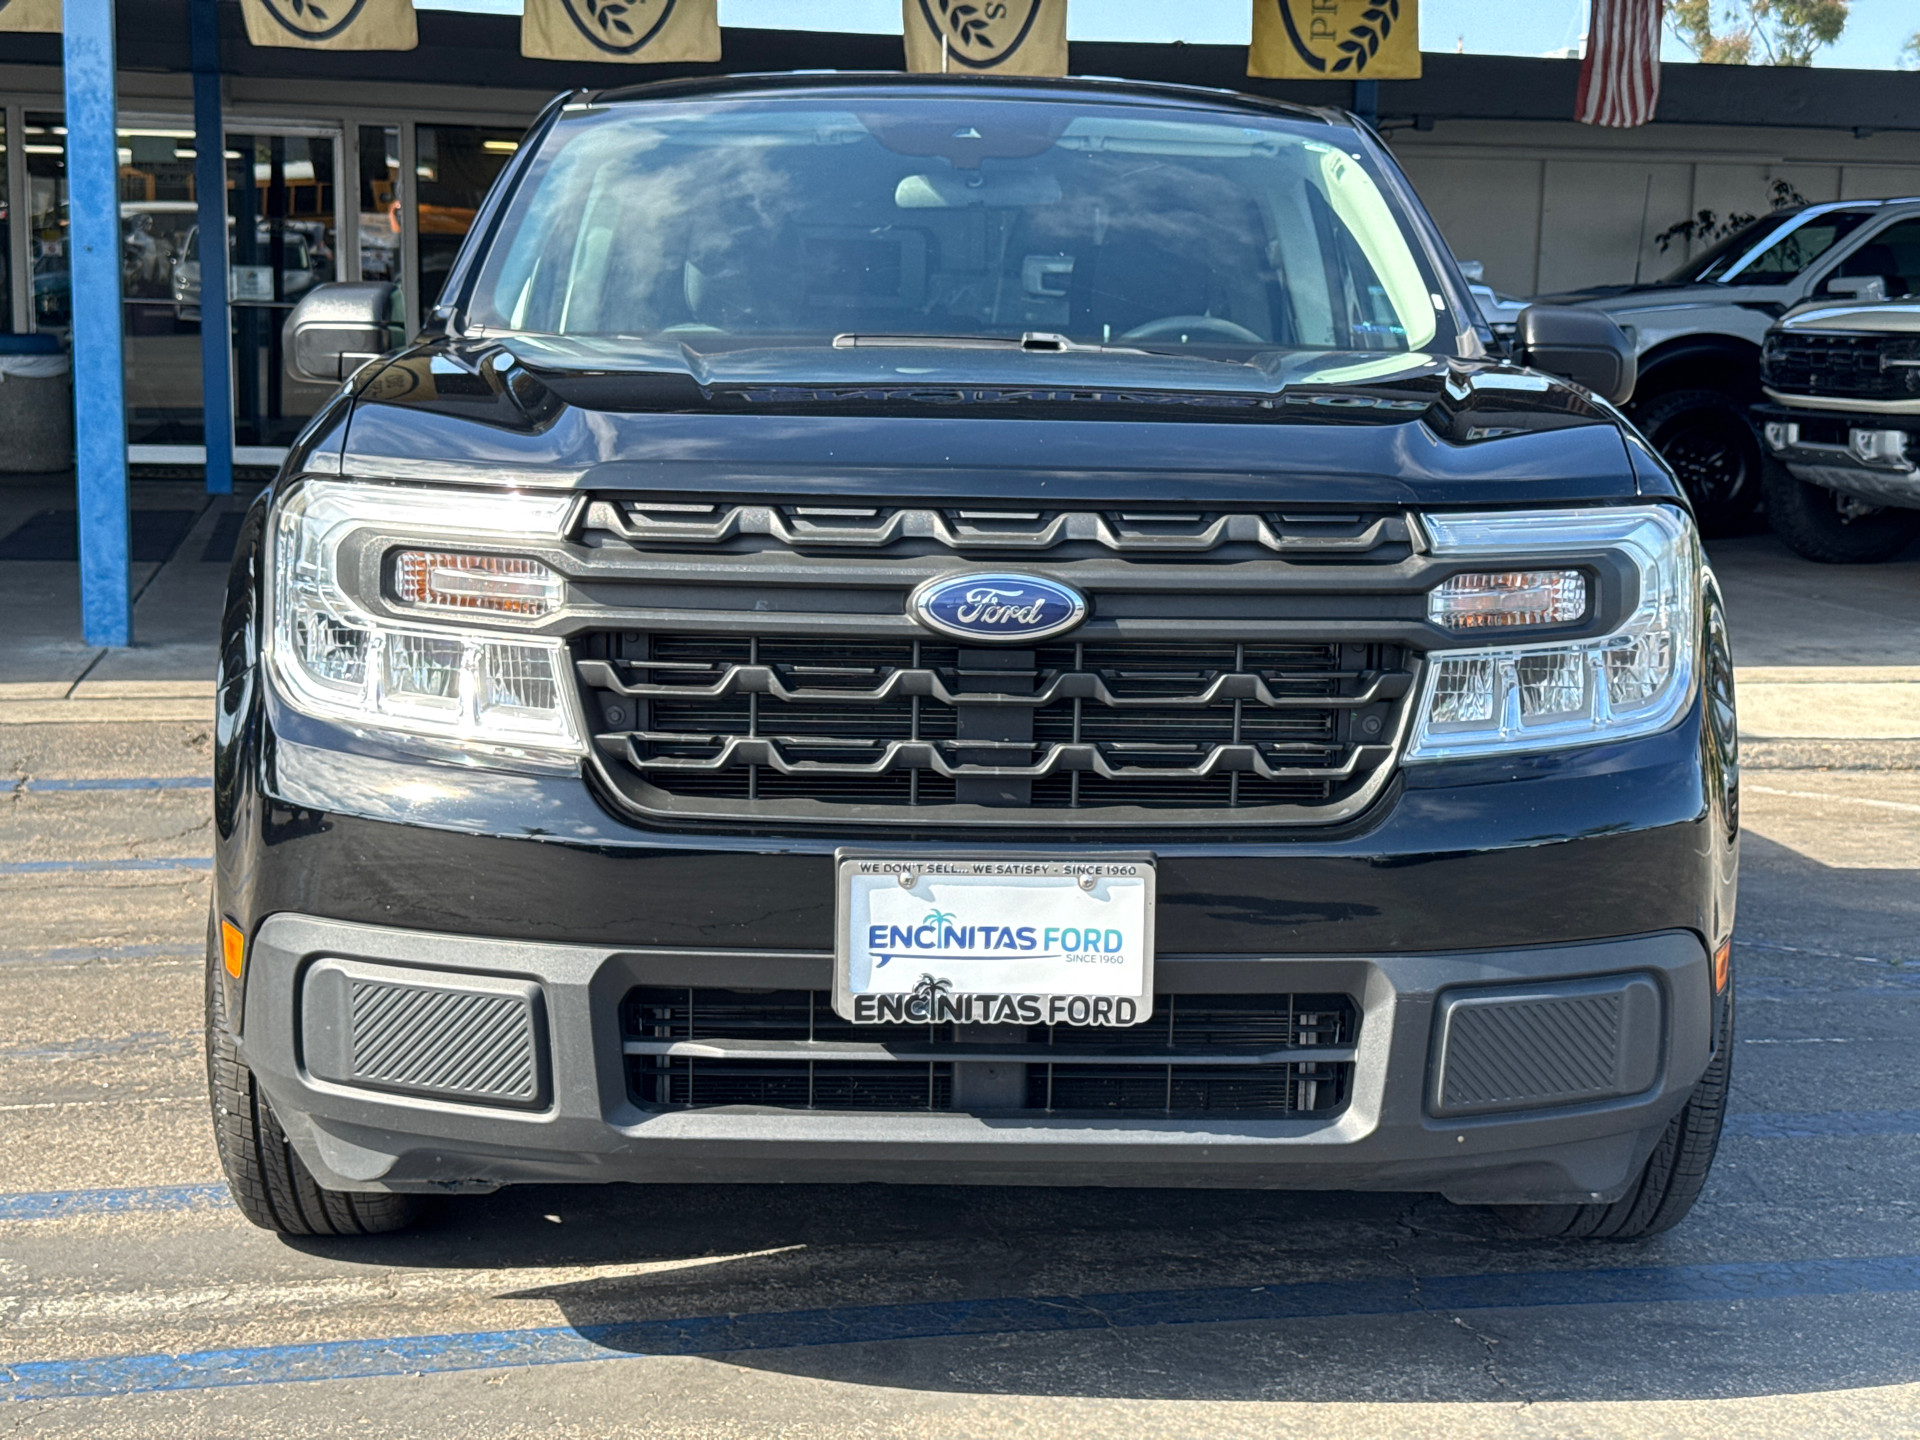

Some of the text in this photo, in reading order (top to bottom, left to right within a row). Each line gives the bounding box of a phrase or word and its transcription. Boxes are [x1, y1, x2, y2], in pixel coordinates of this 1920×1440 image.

[957, 587, 1046, 624] Ford
[860, 864, 880, 873] WE
[883, 864, 923, 873] DON'T
[972, 865, 993, 874] WE
[996, 865, 1049, 874] SATISFY
[1063, 866, 1102, 875] SINCE
[1106, 866, 1137, 875] 1960
[869, 924, 1123, 953] ENCINITAS FORD
[1065, 953, 1124, 964] SINCE 1960
[853, 993, 1137, 1026] ENCINITAS FORD
